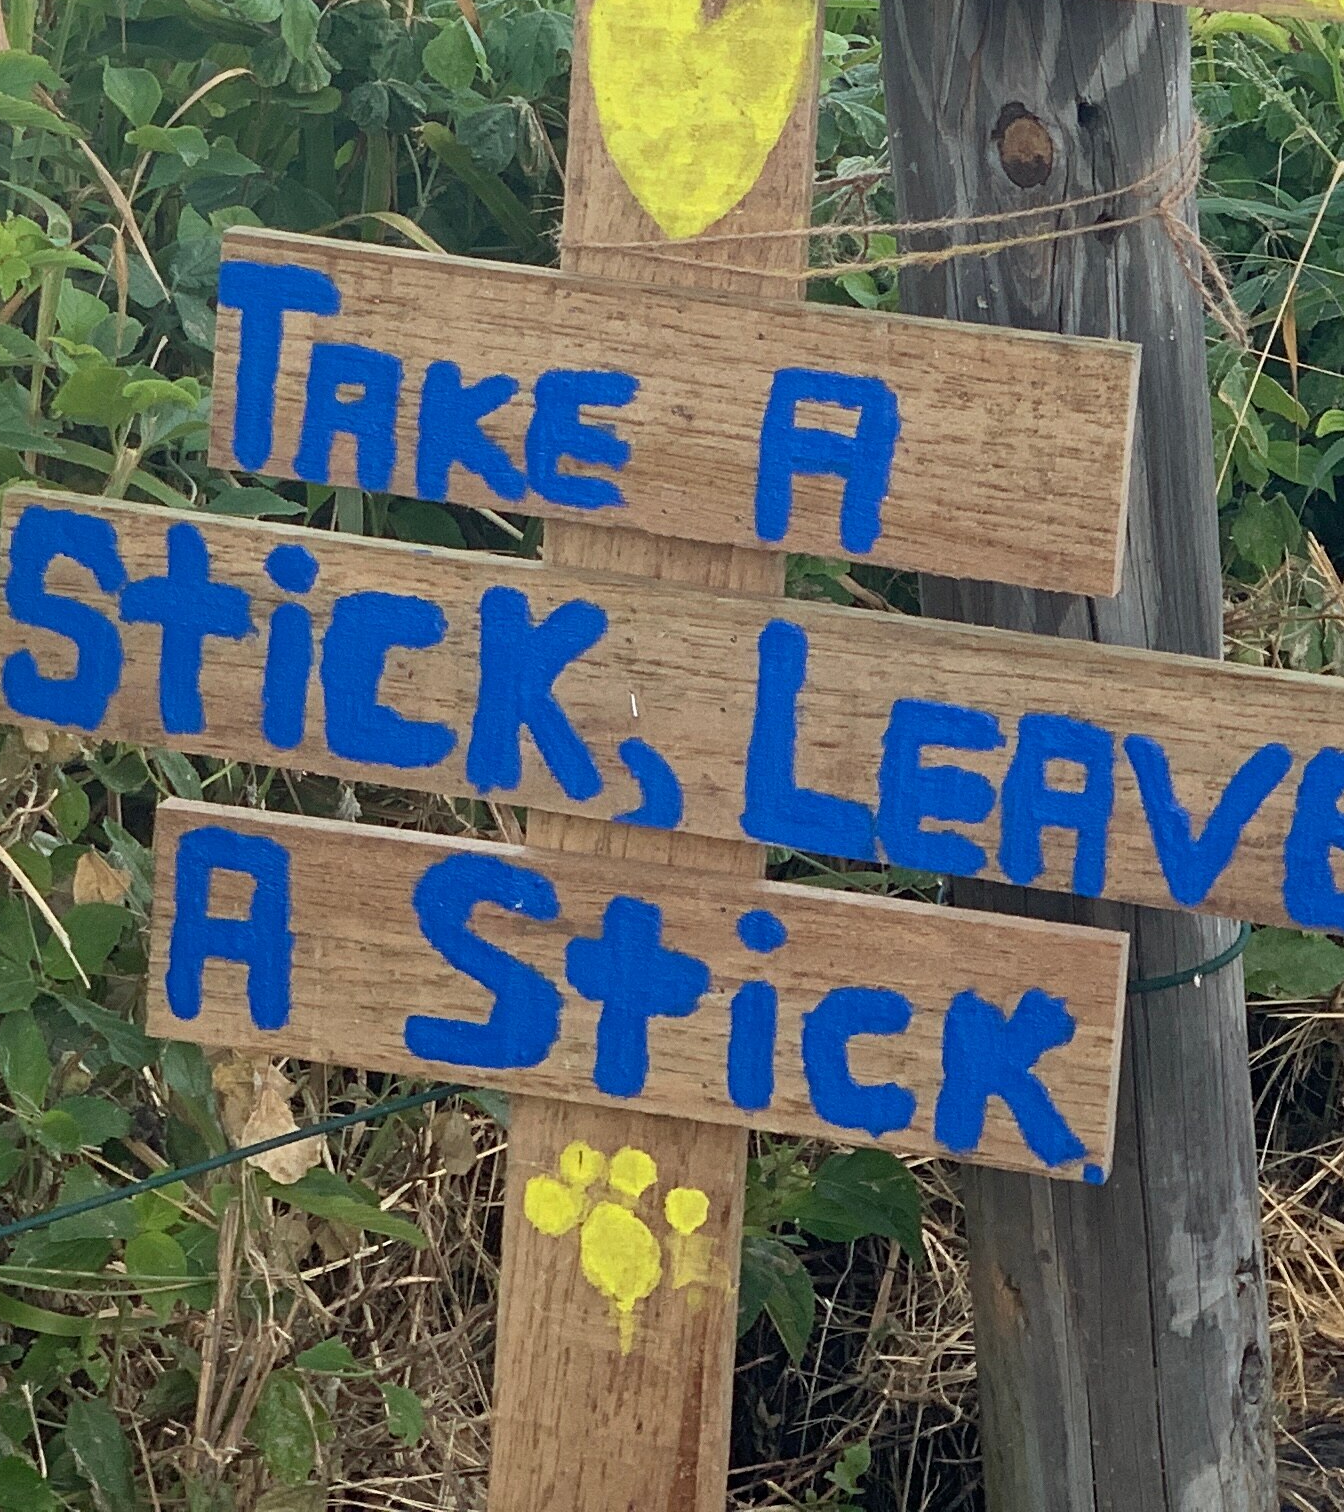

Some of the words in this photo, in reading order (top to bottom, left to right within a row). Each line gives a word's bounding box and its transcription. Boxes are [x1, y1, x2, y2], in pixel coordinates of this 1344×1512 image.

[216, 260, 642, 510] TAKE
[754, 367, 902, 555] A
[165, 825, 295, 1031] A
